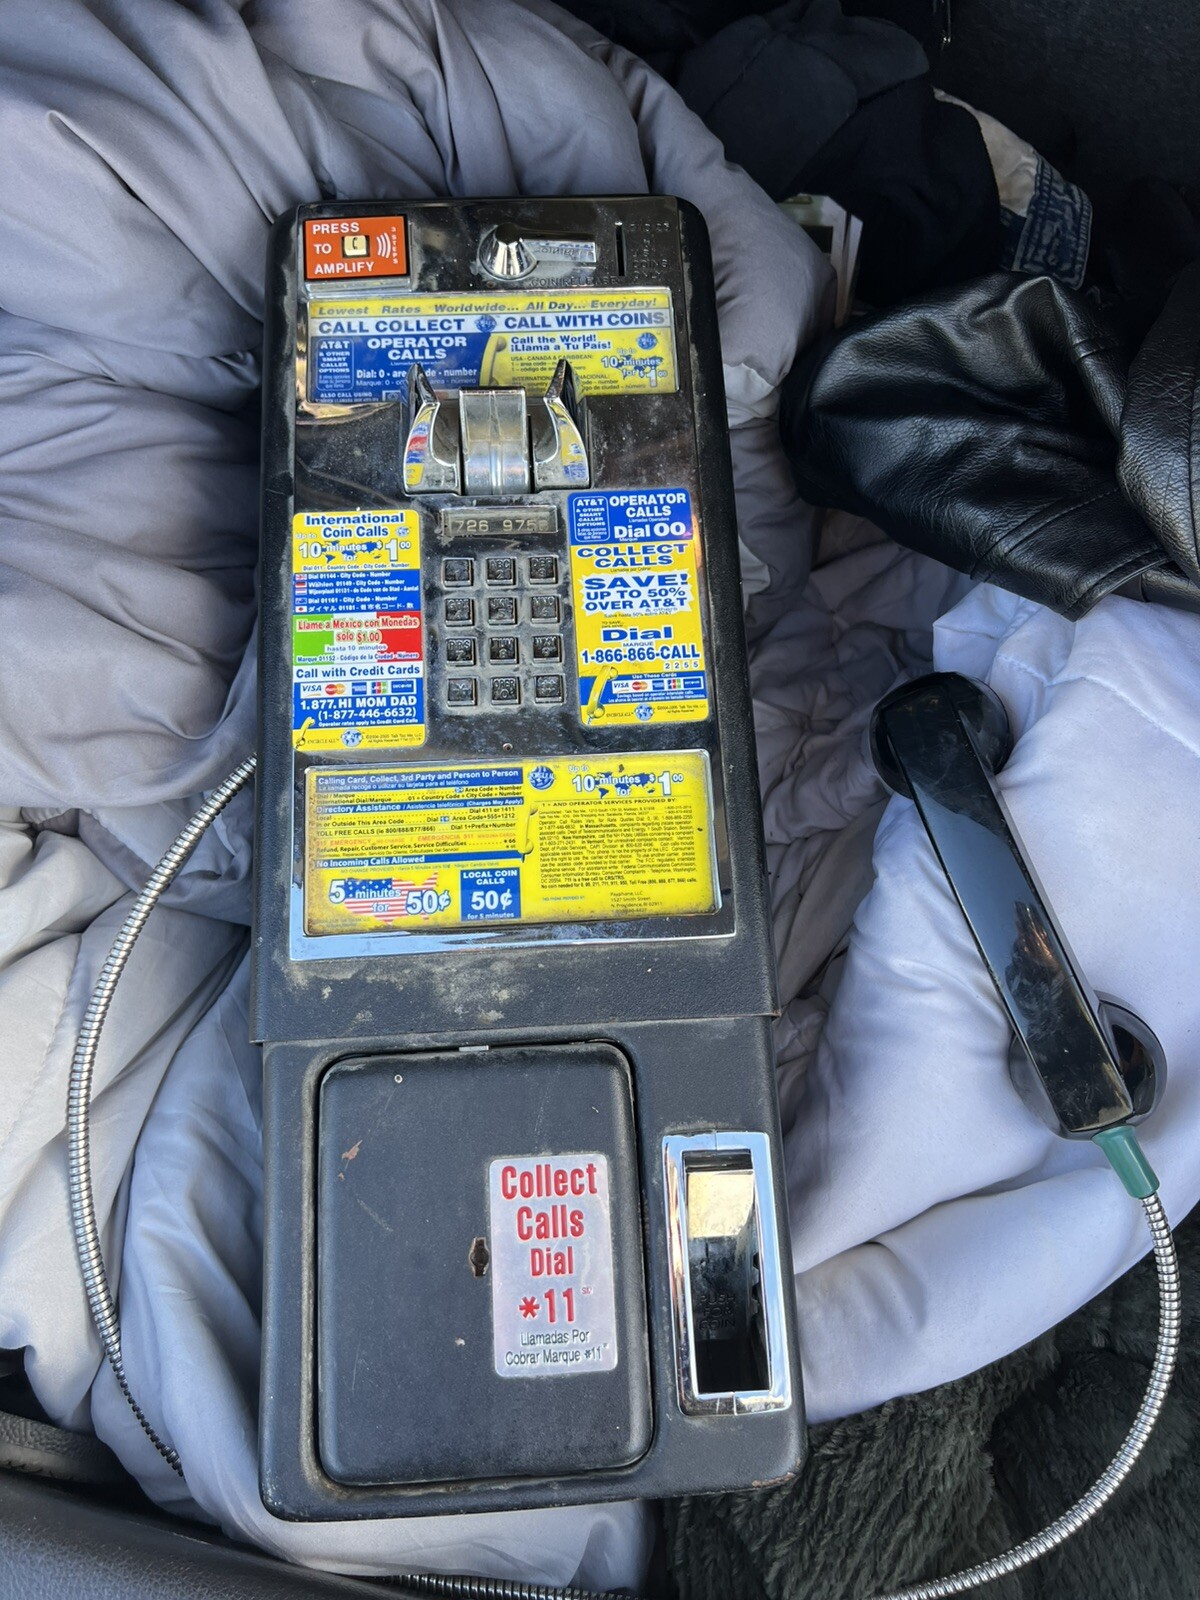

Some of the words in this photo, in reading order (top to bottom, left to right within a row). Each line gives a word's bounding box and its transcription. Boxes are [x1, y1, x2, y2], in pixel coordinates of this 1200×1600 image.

[312, 222, 360, 235] PRESS
[314, 243, 332, 254] TO
[314, 261, 374, 274] AMPLIFY
[531, 278, 558, 287] COIN
[318, 306, 369, 316] Lowest
[382, 305, 421, 314] Rates
[434, 302, 520, 312] Worldwide...
[526, 302, 544, 310] All
[548, 301, 586, 312] Day...
[590, 298, 657, 308] Everyday!
[318, 320, 369, 334] CALL
[375, 318, 465, 332] COLLECT
[504, 316, 552, 329] CALL
[555, 314, 602, 328] WITH
[607, 312, 664, 326] COINS
[367, 336, 467, 349] OPERATOR
[560, 334, 597, 342] World!
[320, 340, 350, 350] AT&T
[388, 348, 446, 360] CALLS
[601, 356, 618, 368] 10
[624, 358, 661, 366] minutes
[356, 368, 377, 378] Dial:
[444, 368, 478, 376] number
[577, 499, 604, 507] AT&T
[609, 493, 686, 507] OPERATOR
[306, 512, 404, 525] International
[626, 506, 672, 518] CALLS
[323, 527, 352, 538] Coin
[356, 526, 388, 537] Calls
[455, 519, 489, 533] 726
[614, 524, 651, 538] Dial
[299, 542, 322, 558] 10
[326, 542, 368, 552] minutes
[577, 544, 688, 557] COLLECT
[595, 555, 673, 568] CALLS
[584, 574, 688, 589] SAVE!
[586, 591, 611, 600] UP
[617, 589, 642, 599] TO
[648, 587, 686, 597] 50%
[585, 600, 633, 611] OVER
[640, 598, 687, 608] AT&T
[298, 621, 322, 630] Llame
[381, 617, 418, 626] Monedas
[356, 632, 380, 642] $1.00
[602, 626, 673, 642] Dial
[582, 644, 700, 663] 1-866-866-CALL
[296, 668, 318, 678] Call
[322, 667, 346, 677] with
[350, 666, 384, 676] Credit
[388, 665, 420, 674] Cards
[356, 697, 386, 708] MOM
[390, 696, 417, 706] DAD
[318, 707, 416, 721] (1-877-446-6632)
[318, 777, 345, 785] Calling
[370, 775, 399, 784] Collect,
[415, 773, 435, 781] Party
[572, 775, 596, 792] 10
[599, 774, 641, 785] minutes
[616, 787, 631, 796] for
[356, 804, 400, 812] Assistance
[330, 858, 369, 867] Incoming
[371, 857, 390, 865] Calls
[463, 871, 492, 879] LOCAL
[328, 878, 346, 904] 5
[355, 888, 402, 899] minutes
[373, 903, 389, 913] for
[405, 890, 452, 914] 50¢
[471, 889, 513, 910] 50¢
[500, 1163, 598, 1200] Collect
[516, 1204, 584, 1240] Calls
[530, 1246, 574, 1277] Dial
[700, 1319, 736, 1330] COIN
[521, 1330, 569, 1346] Llamadas
[572, 1329, 590, 1342] Por
[505, 1350, 540, 1366] Cobrar
[543, 1349, 581, 1365] Marque
